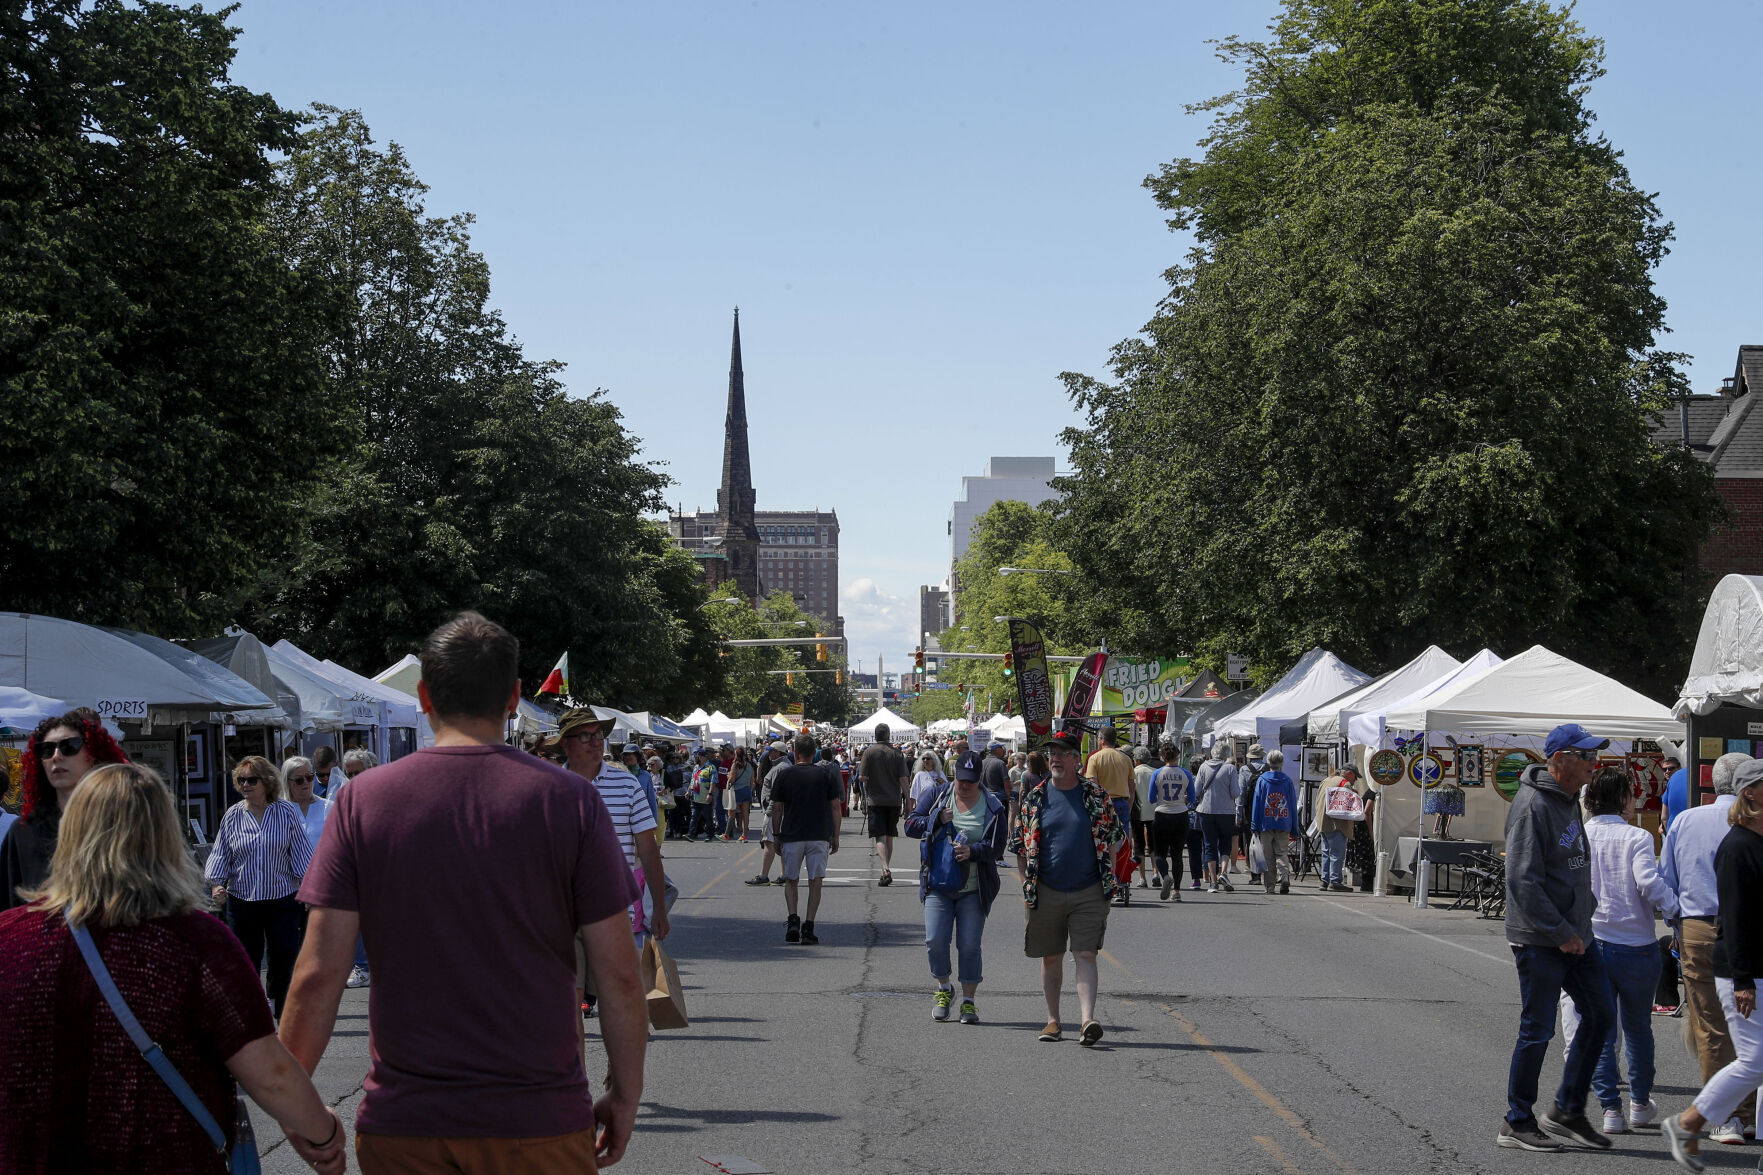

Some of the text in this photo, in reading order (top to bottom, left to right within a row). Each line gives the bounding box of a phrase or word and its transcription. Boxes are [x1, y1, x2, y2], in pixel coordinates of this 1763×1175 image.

[1108, 660, 1161, 687] FRIED
[1122, 676, 1186, 708] DOUGH
[97, 700, 146, 715] SPORTS
[1162, 783, 1182, 801] 17
[1264, 807, 1288, 818] BILLS
[1568, 855, 1585, 870] LIG
